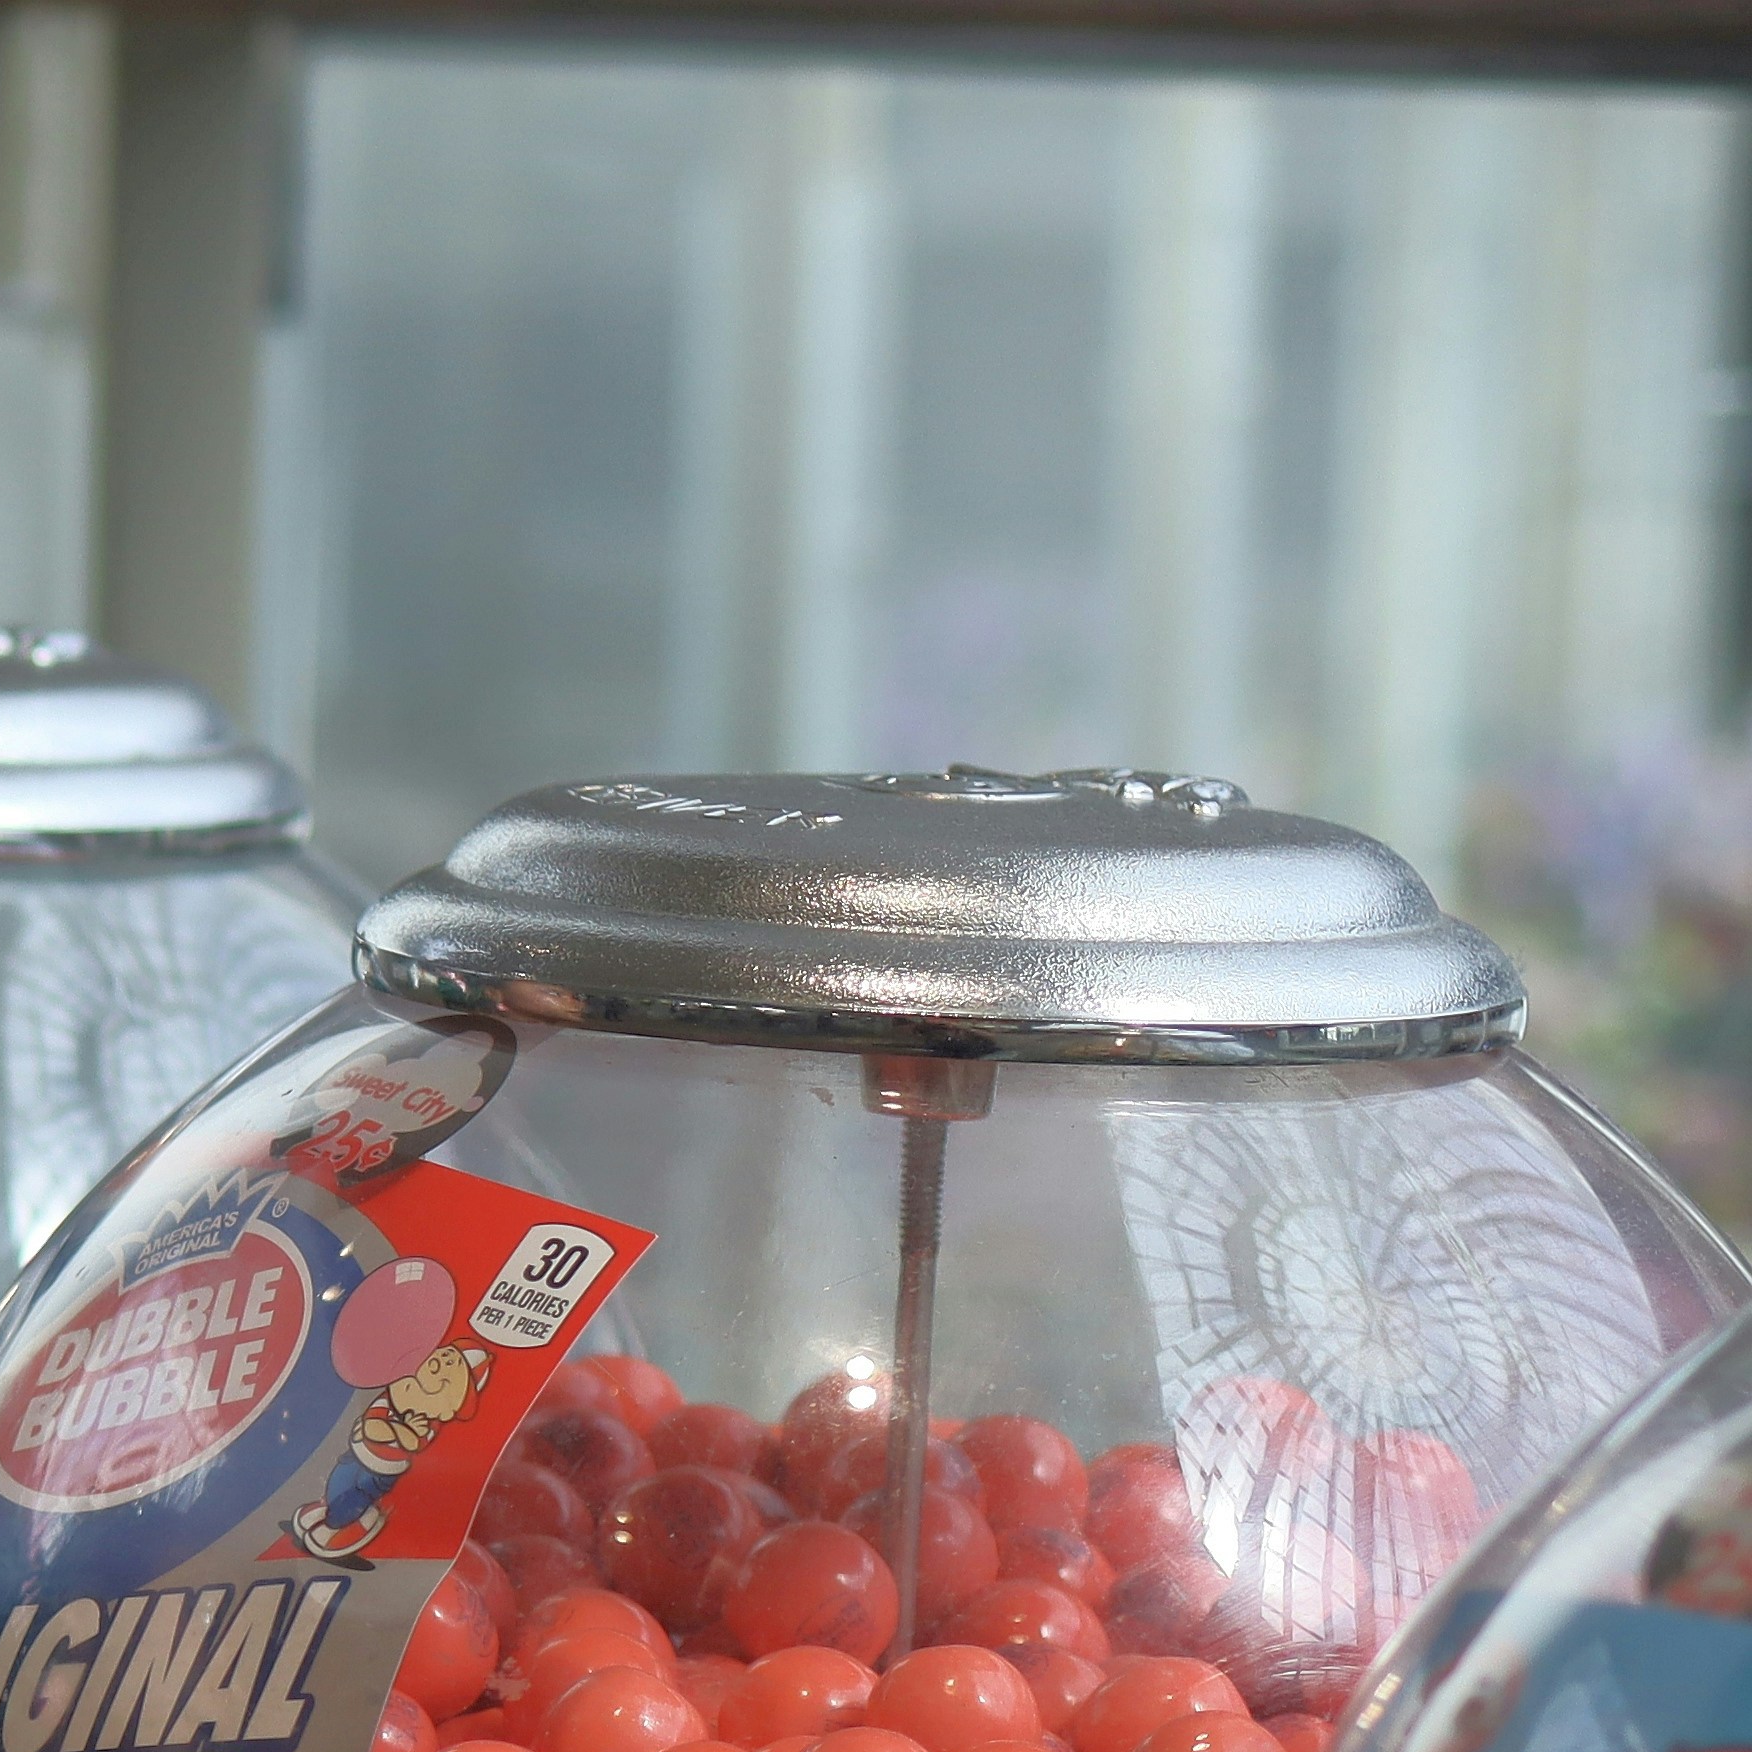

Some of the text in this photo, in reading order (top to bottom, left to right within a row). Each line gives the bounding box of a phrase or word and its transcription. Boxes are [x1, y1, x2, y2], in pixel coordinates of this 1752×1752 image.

[332, 1066, 456, 1126] Sweet City
[285, 1109, 398, 1173] 25¢
[134, 1231, 221, 1275] ORIGINAL
[137, 1210, 240, 1261] AMERICA'S
[522, 1237, 590, 1290] 30
[36, 1266, 284, 1387] DUBBLE
[476, 1306, 553, 1340] PER 1 PIECE
[489, 1281, 570, 1319] CALORIES
[12, 1339, 266, 1452] BUBBLE
